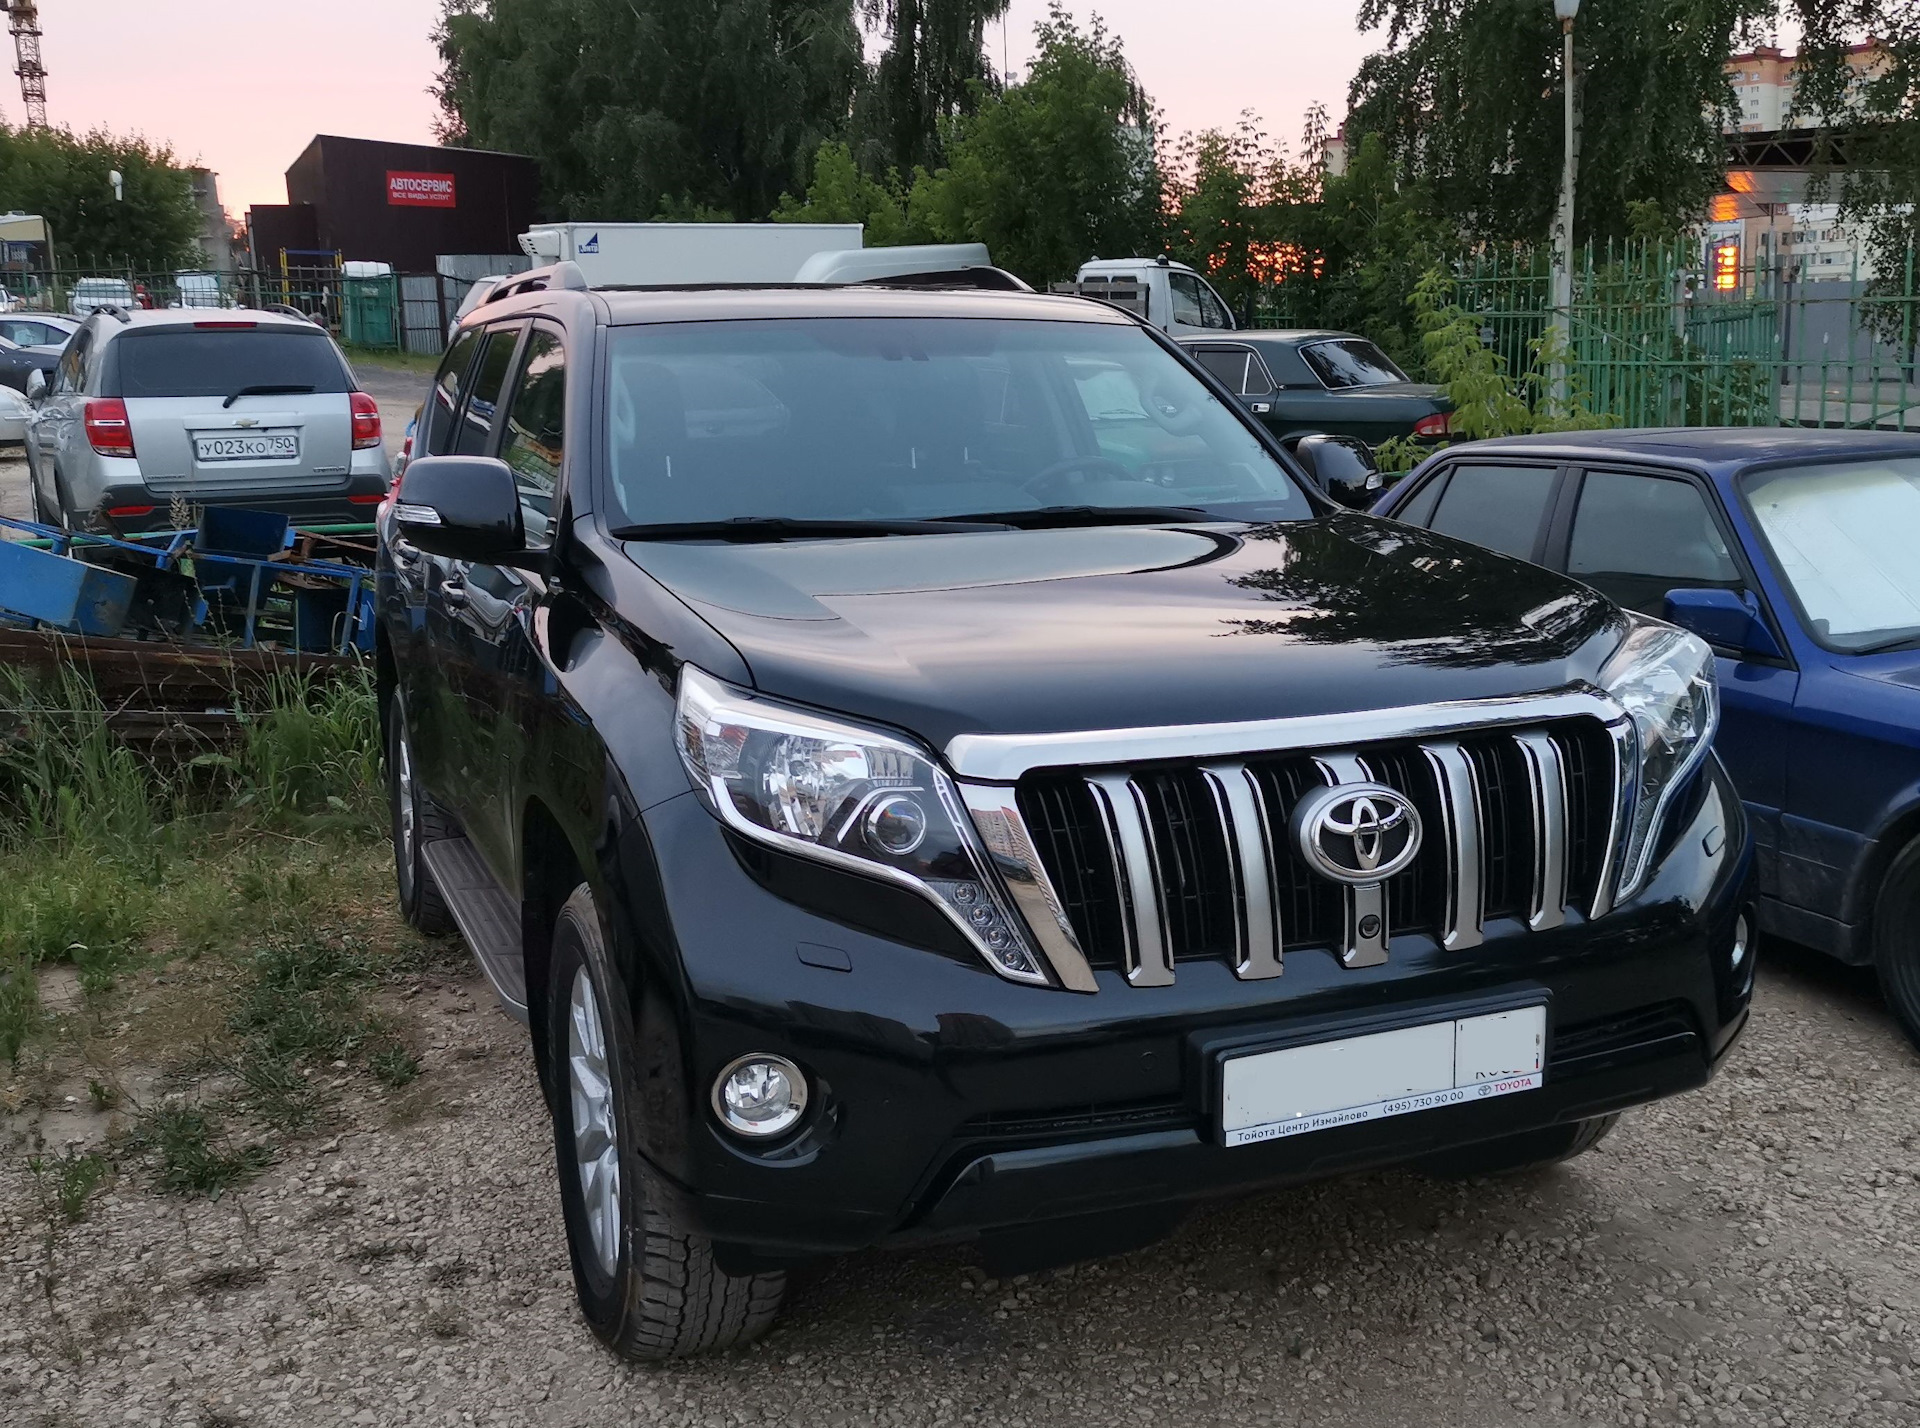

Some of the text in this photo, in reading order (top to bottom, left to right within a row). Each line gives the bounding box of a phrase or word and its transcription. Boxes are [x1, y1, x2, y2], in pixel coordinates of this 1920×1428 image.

[390, 177, 453, 193] АВТОСЕРВИС
[392, 191, 407, 199] ВСЕ
[1494, 1078, 1532, 1092] TOYOTA
[1237, 1090, 1464, 1142] Тойота Центр Измайлово (495) 730 90 00
